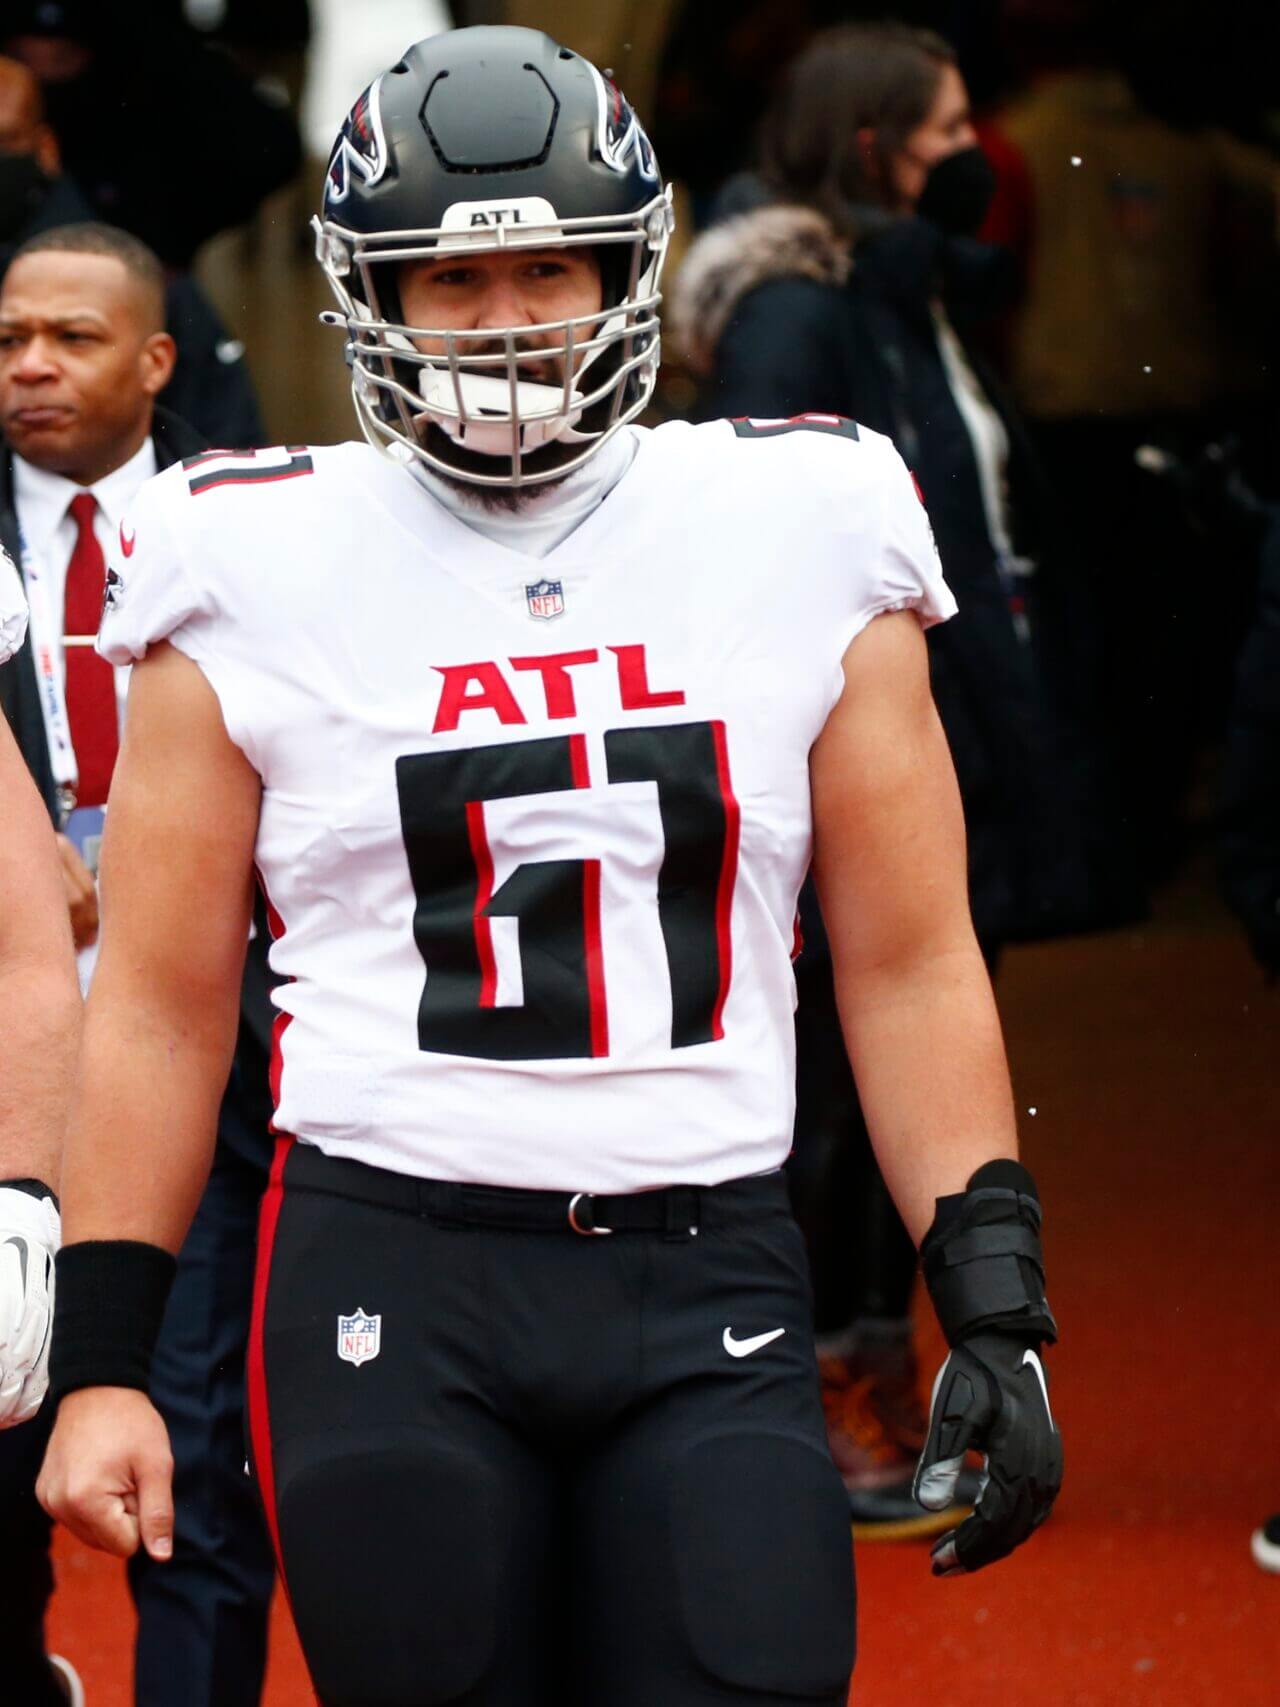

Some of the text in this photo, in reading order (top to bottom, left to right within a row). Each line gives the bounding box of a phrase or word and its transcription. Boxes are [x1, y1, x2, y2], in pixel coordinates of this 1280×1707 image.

[470, 210, 529, 226] ATL
[531, 595, 561, 615] NFL
[429, 644, 685, 734] ATL
[396, 720, 740, 1060] 61
[344, 1335, 374, 1355] NFL
